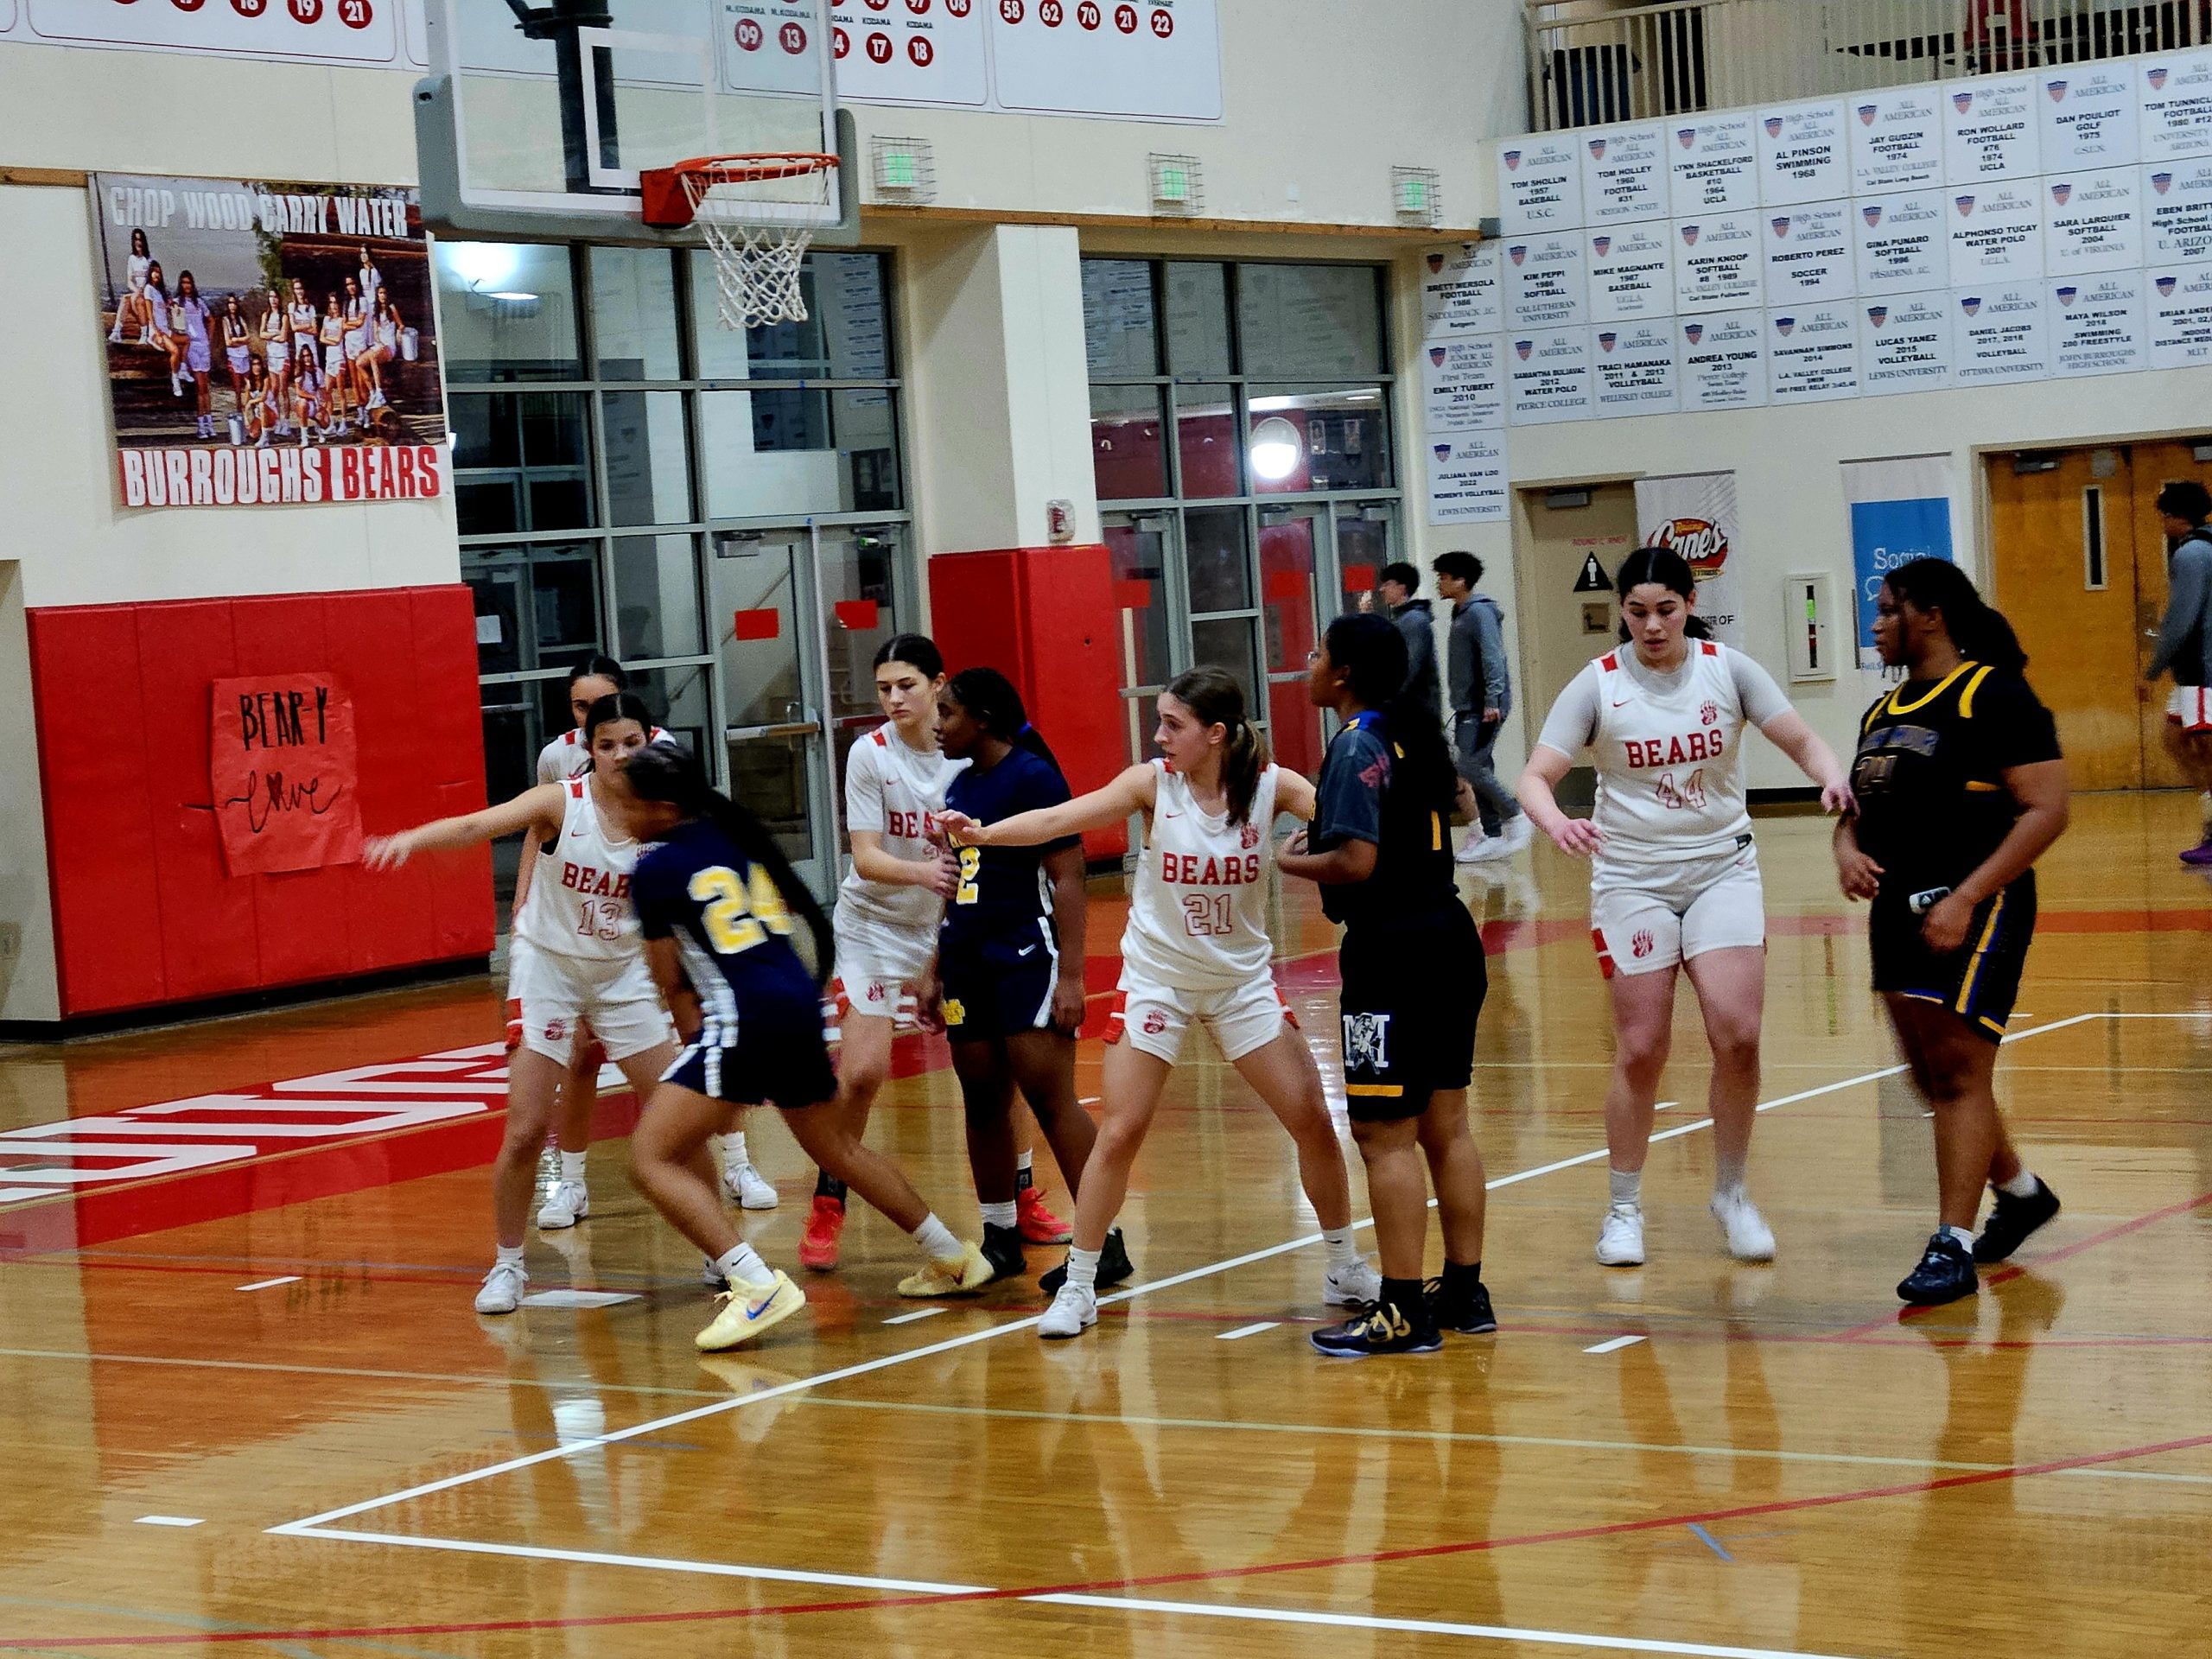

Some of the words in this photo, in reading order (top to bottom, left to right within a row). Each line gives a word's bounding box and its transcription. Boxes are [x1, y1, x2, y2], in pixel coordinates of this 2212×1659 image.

[345, 1, 365, 22] 21
[1004, 1, 1020, 18] 58
[1042, 4, 1059, 22] 62
[1081, 7, 1097, 25] 70
[1119, 10, 1133, 28] 21
[1154, 15, 1170, 32] 22
[738, 24, 759, 44] 09
[785, 29, 800, 48] 13
[871, 39, 887, 58] 17
[912, 41, 928, 61] 18
[2144, 102, 2164, 111] TOM
[2163, 105, 2212, 118] FOOTBALL
[2056, 114, 2075, 124] DAN
[2078, 109, 2121, 121] POULIOT
[1956, 127, 1976, 137] RON
[1979, 121, 2024, 134] WOLLARD
[2075, 121, 2101, 131] GOLF
[1867, 136, 1885, 144] JAY
[1967, 132, 2016, 144] FOOTBALL
[2078, 130, 2100, 141] 1975
[1775, 149, 1788, 159] AL
[1791, 144, 1831, 157] PINSON
[1872, 140, 1920, 153] FOOTBALL
[1886, 152, 1908, 161] 1974
[1775, 156, 1831, 170] SWIMMING
[1979, 162, 2005, 172] UCLA
[1597, 169, 1616, 178] TOM
[1685, 166, 1742, 180] BASKETBALL
[1791, 168, 1816, 179] 1968
[1510, 180, 1528, 188] TOM
[1604, 183, 1648, 195] FOOTBALL
[1518, 194, 1561, 206] BASEBALL
[1703, 194, 1726, 204] UCLA
[110, 187, 173, 228] CHOP
[181, 190, 253, 232] WOOD
[257, 193, 336, 234] CARRY
[334, 195, 409, 237] WATER
[2156, 205, 2183, 215] EBEN
[2052, 218, 2078, 228] SARA
[2176, 213, 2208, 225] School
[1952, 226, 2003, 239] ALPHONSO
[2005, 223, 2037, 233] TUCAY
[2067, 223, 2117, 236] SOFTBALL
[1866, 239, 1888, 249] GINA
[1891, 235, 1929, 245] PUNARO
[1965, 237, 1997, 247] WATER
[2000, 234, 2025, 244] POLO
[2081, 234, 2103, 244] 2004
[1771, 251, 1813, 263] ROBERTO
[1815, 247, 1845, 257] PEREZ
[1874, 245, 1922, 257] SOFTBALL
[1984, 245, 2005, 255] 2001
[1687, 256, 1714, 266] KARIN
[1717, 252, 1750, 263] KNOOP
[1592, 267, 1615, 276] MIKE
[1617, 262, 1665, 274] MAGNANTE
[1695, 263, 1740, 274] SOFTBALL
[1790, 267, 1827, 278] SOCCER
[1522, 272, 1538, 281] KIM
[1541, 270, 1565, 279] PEPPI
[1799, 277, 1820, 286] 1994
[1522, 287, 1566, 298] SOFTBALL
[1607, 281, 1651, 292] BASEBALL
[1440, 288, 1482, 300] FOOTBALL
[2065, 312, 2089, 321] MAYA
[2091, 308, 2127, 319] WILSON
[1968, 327, 1997, 337] DANIEL
[2074, 327, 2121, 339] SWIMMING
[1875, 337, 1904, 346] LUCAS
[1907, 334, 1938, 344] YANEZ
[2080, 334, 2132, 346] FREESTYLE
[1895, 345, 1917, 353] 2015
[1976, 347, 2027, 359] VOLLEYBALL
[1687, 353, 1724, 365] ANDREA
[1726, 350, 1758, 361] YOUNG
[1802, 353, 1823, 362] 2014
[1878, 352, 1936, 365] VOLLEYBALL
[1597, 363, 1622, 372] TRACI
[1624, 358, 1671, 370] HAMANAKA
[1711, 362, 1732, 372] 2013
[1604, 372, 1624, 380] 2011
[1896, 365, 1948, 378] UNIVERSITY
[1539, 378, 1560, 386] 2012
[1609, 376, 1662, 389] VOLLEYBALL
[1433, 385, 1458, 395] EMILY
[1459, 382, 1495, 392] TUBERT
[1524, 386, 1553, 397] WATER
[1554, 385, 1577, 393] POLO
[1452, 392, 1476, 402] 2010
[1516, 400, 1547, 410] PIERCE
[1547, 397, 1587, 408] COLLEGE
[124, 448, 323, 507] BURROUGHS
[343, 446, 441, 499] BEARS
[1437, 471, 1466, 480] JULIANA
[1465, 488, 1504, 498] VOLLEYBALL
[1719, 614, 1734, 626] OF
[1625, 729, 1724, 768] BEARS
[1656, 768, 1707, 810] 44
[1162, 852, 1260, 886] BEARS
[561, 861, 632, 899] BEAR
[686, 865, 791, 955] 24
[1181, 893, 1233, 937] 21
[576, 899, 622, 941] 13
